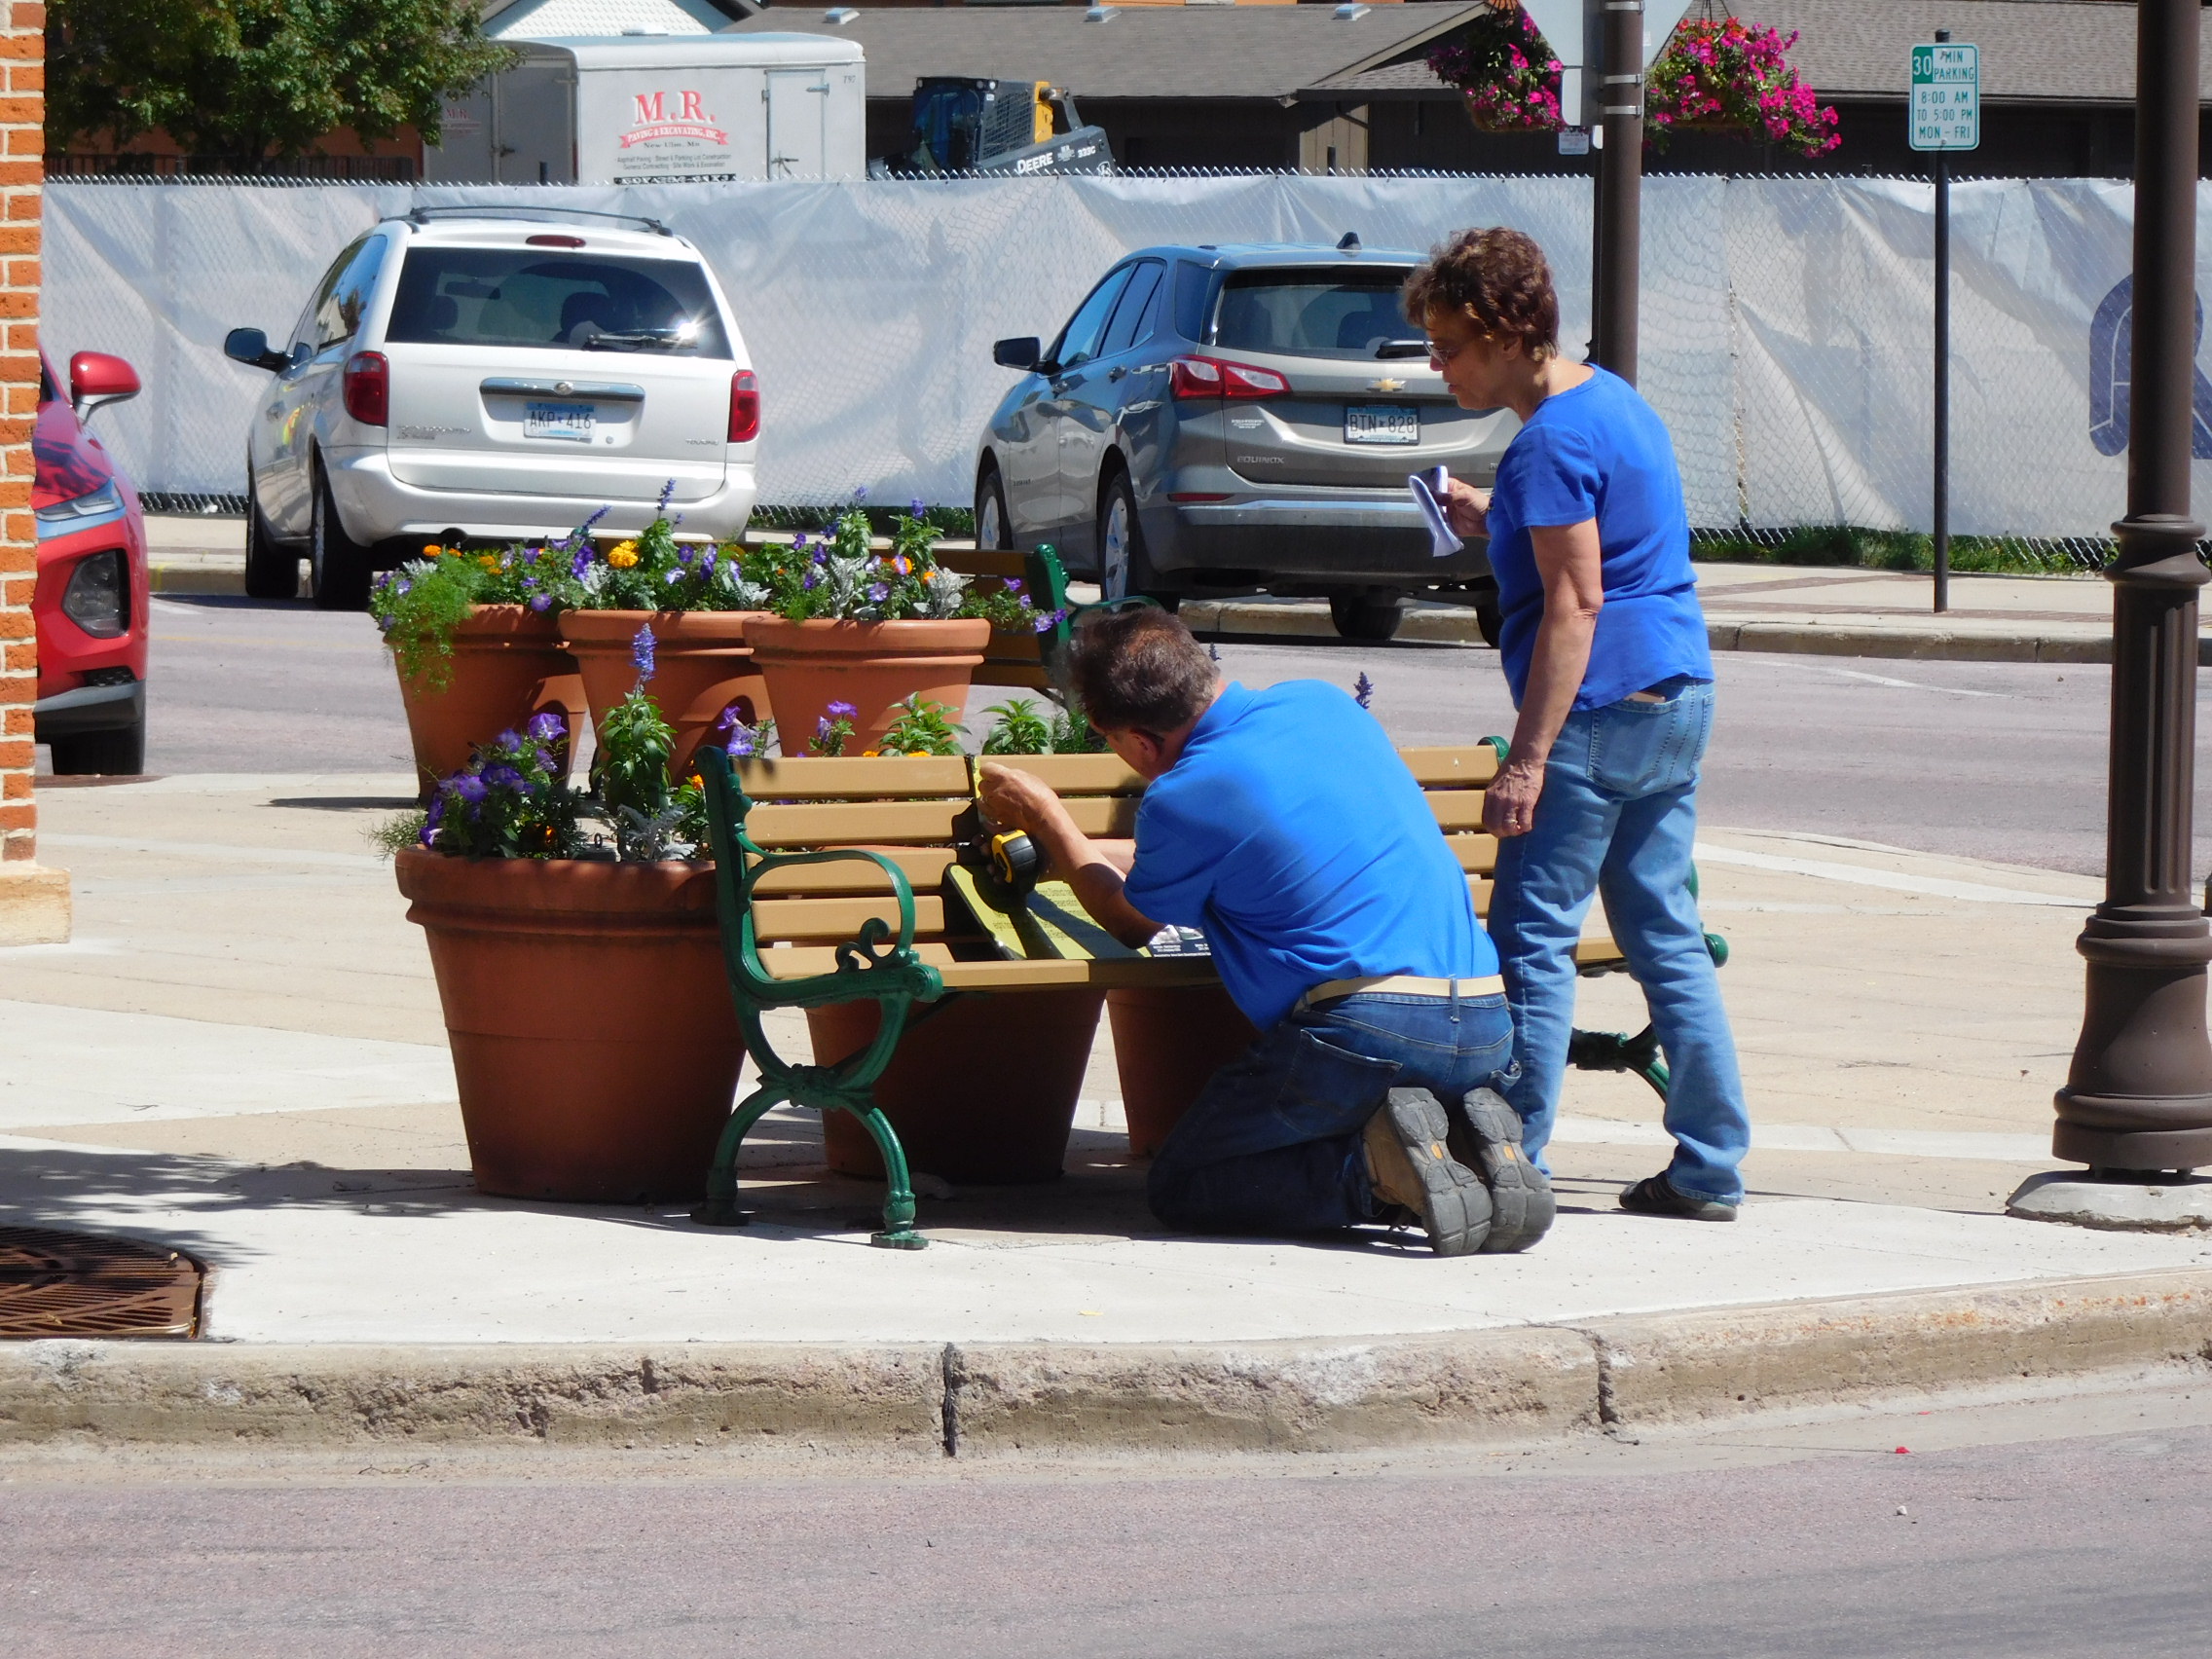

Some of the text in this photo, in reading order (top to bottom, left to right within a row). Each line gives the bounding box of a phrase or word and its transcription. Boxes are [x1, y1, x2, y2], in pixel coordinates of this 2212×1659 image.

[1945, 51, 1963, 63] MIN
[1913, 55, 1933, 76] 30
[1934, 67, 1974, 80] PARKING
[1921, 92, 1969, 104] 8:00 AM
[633, 90, 717, 126] M.R.
[1916, 109, 1972, 122] TO 5:00 PM
[628, 129, 653, 142] PAVING
[1919, 126, 1940, 139] MON
[1954, 126, 1971, 138] FRI
[1017, 152, 1053, 174] DEERE
[530, 411, 591, 429] AKP 416
[1349, 414, 1415, 434] BTN 828
[1236, 456, 1285, 464] EQUINOX
